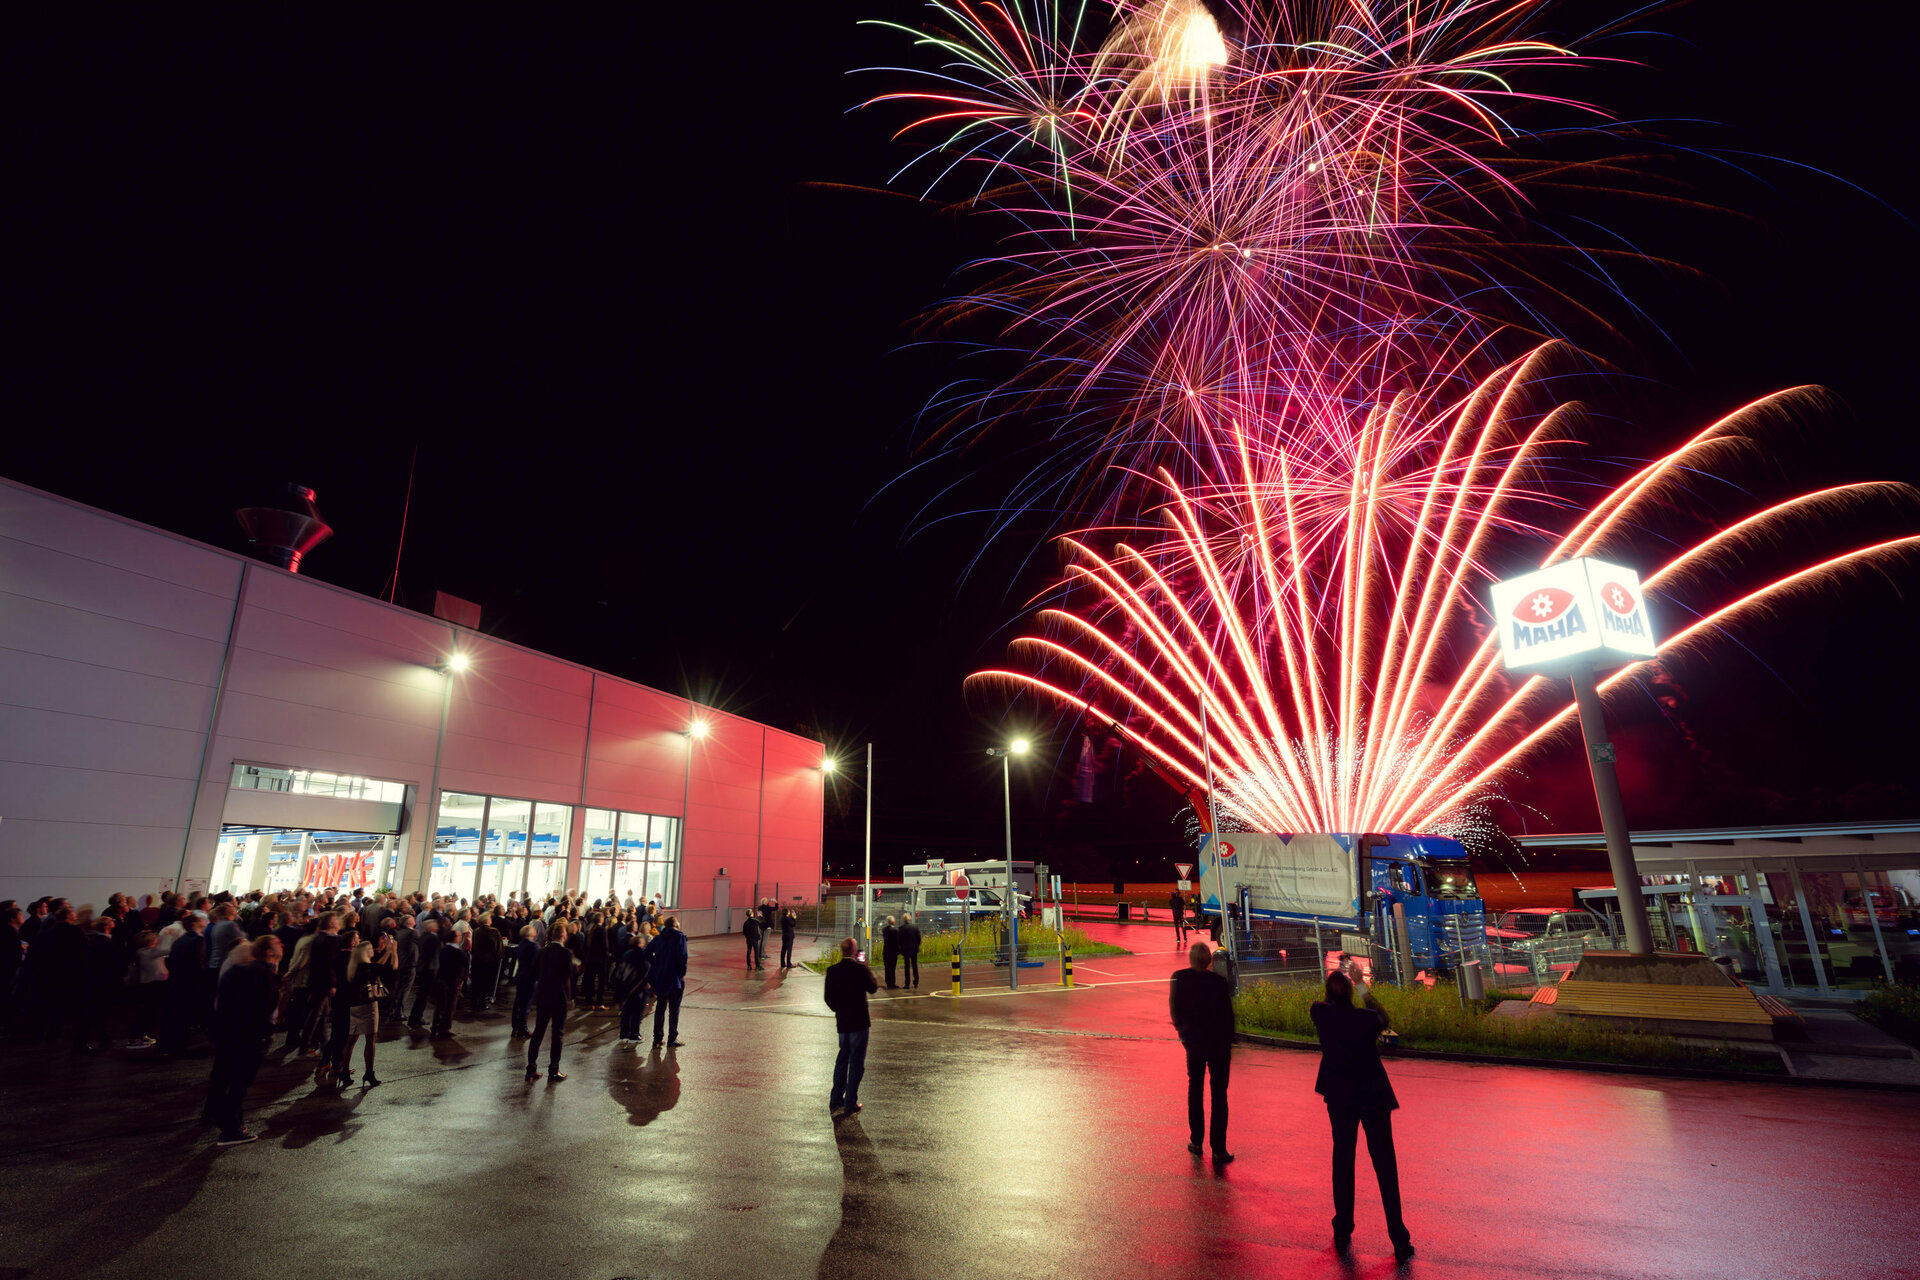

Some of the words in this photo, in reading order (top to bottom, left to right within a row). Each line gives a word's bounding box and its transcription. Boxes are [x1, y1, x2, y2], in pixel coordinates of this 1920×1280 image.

[1512, 602, 1587, 650] MAHA
[1601, 601, 1646, 638] MAHA
[302, 851, 376, 889] DANKE
